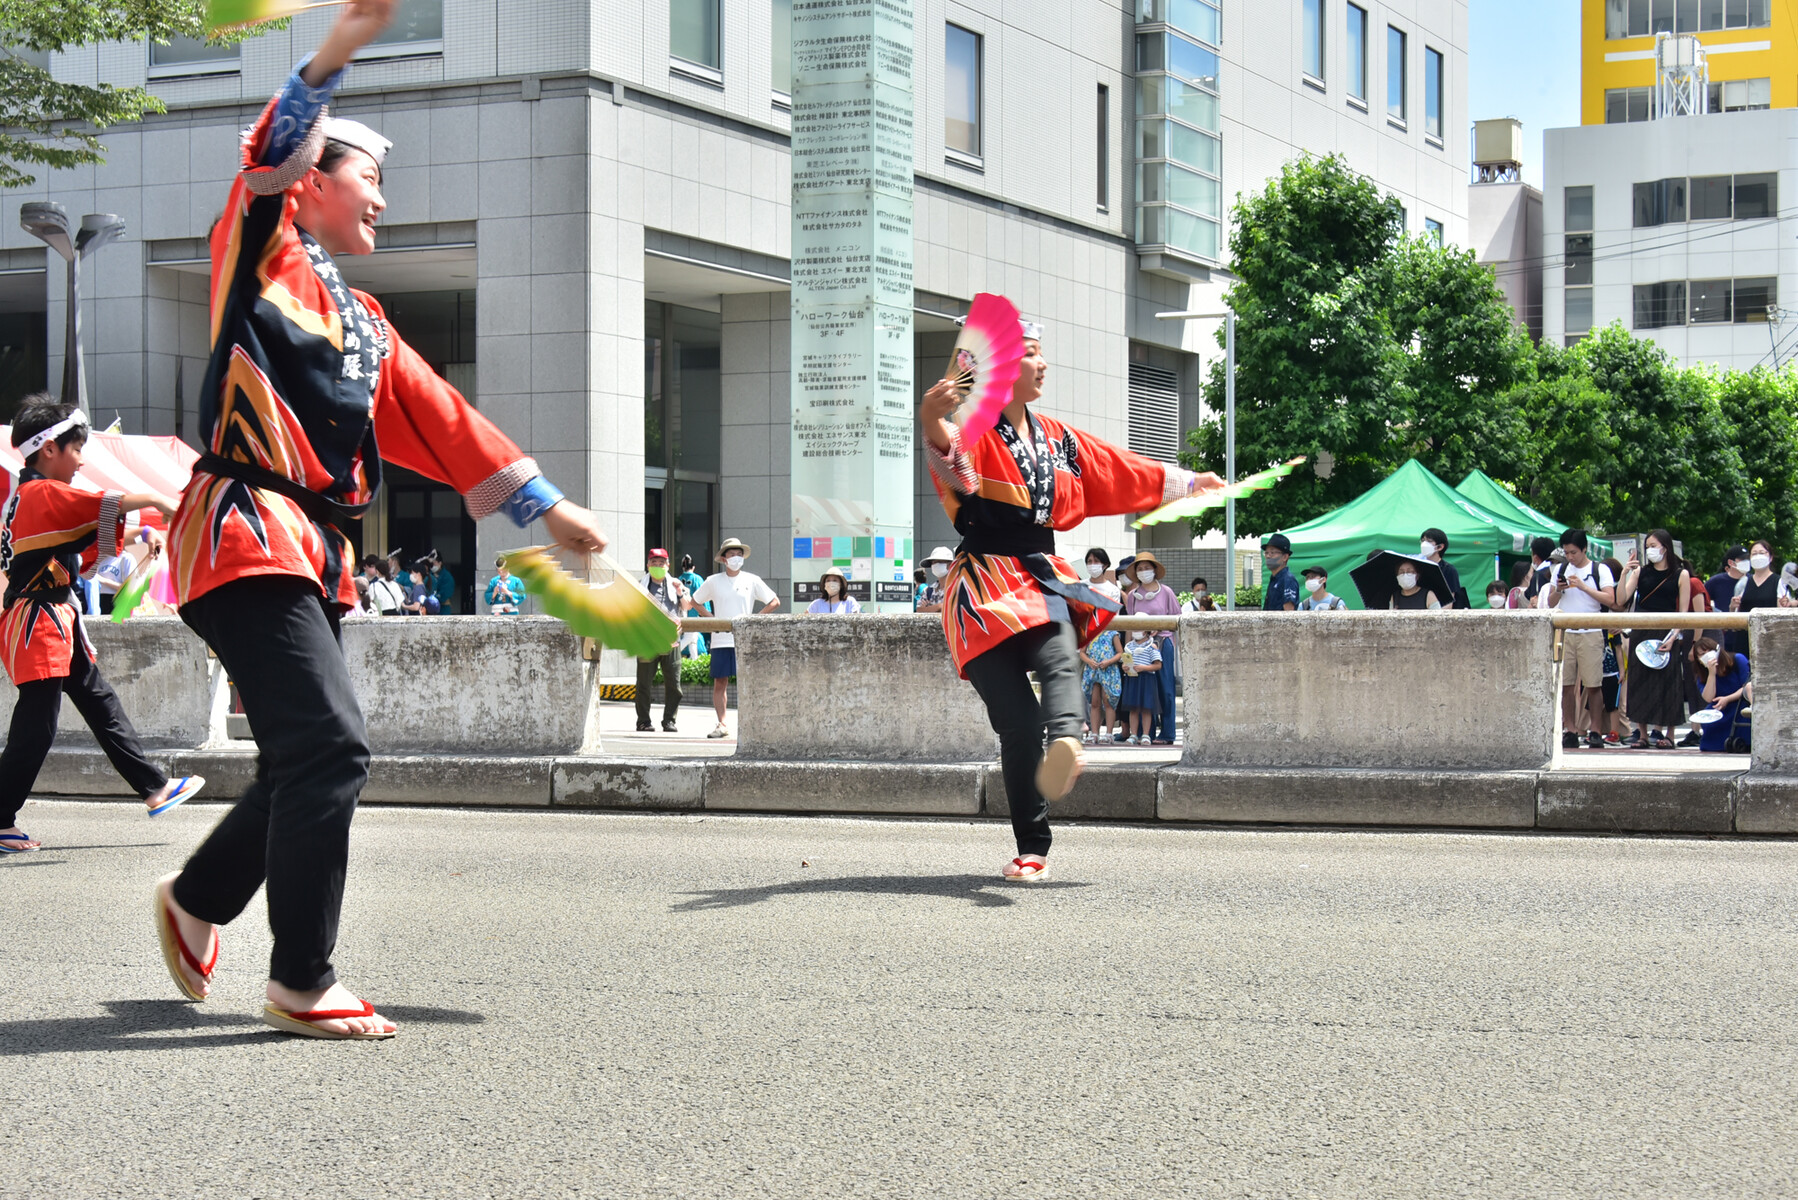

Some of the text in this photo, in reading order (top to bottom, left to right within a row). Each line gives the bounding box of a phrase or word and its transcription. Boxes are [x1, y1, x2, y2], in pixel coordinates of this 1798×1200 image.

[798, 61, 867, 72] ソニー生命保険株式会社
[794, 112, 818, 122] 株式会社
[794, 121, 871, 133] 株式会社ファミリーライフサービス
[796, 209, 868, 220] NTTファイナンス株式会社
[802, 221, 863, 231] 株式会社サカタのタネ
[805, 244, 861, 254] 株式会社 メニコン
[846, 254, 871, 263] 仙台支店
[793, 265, 872, 277] 株式会社 エスイー 東北支店
[800, 310, 865, 320] ハローワーク仙台
[809, 399, 855, 408] 宝印刷株式会社
[798, 431, 867, 440] 株式会社 エネサンス東北
[805, 440, 860, 448] エイジェックグループ
[802, 449, 863, 458] 建設総合技術センター
